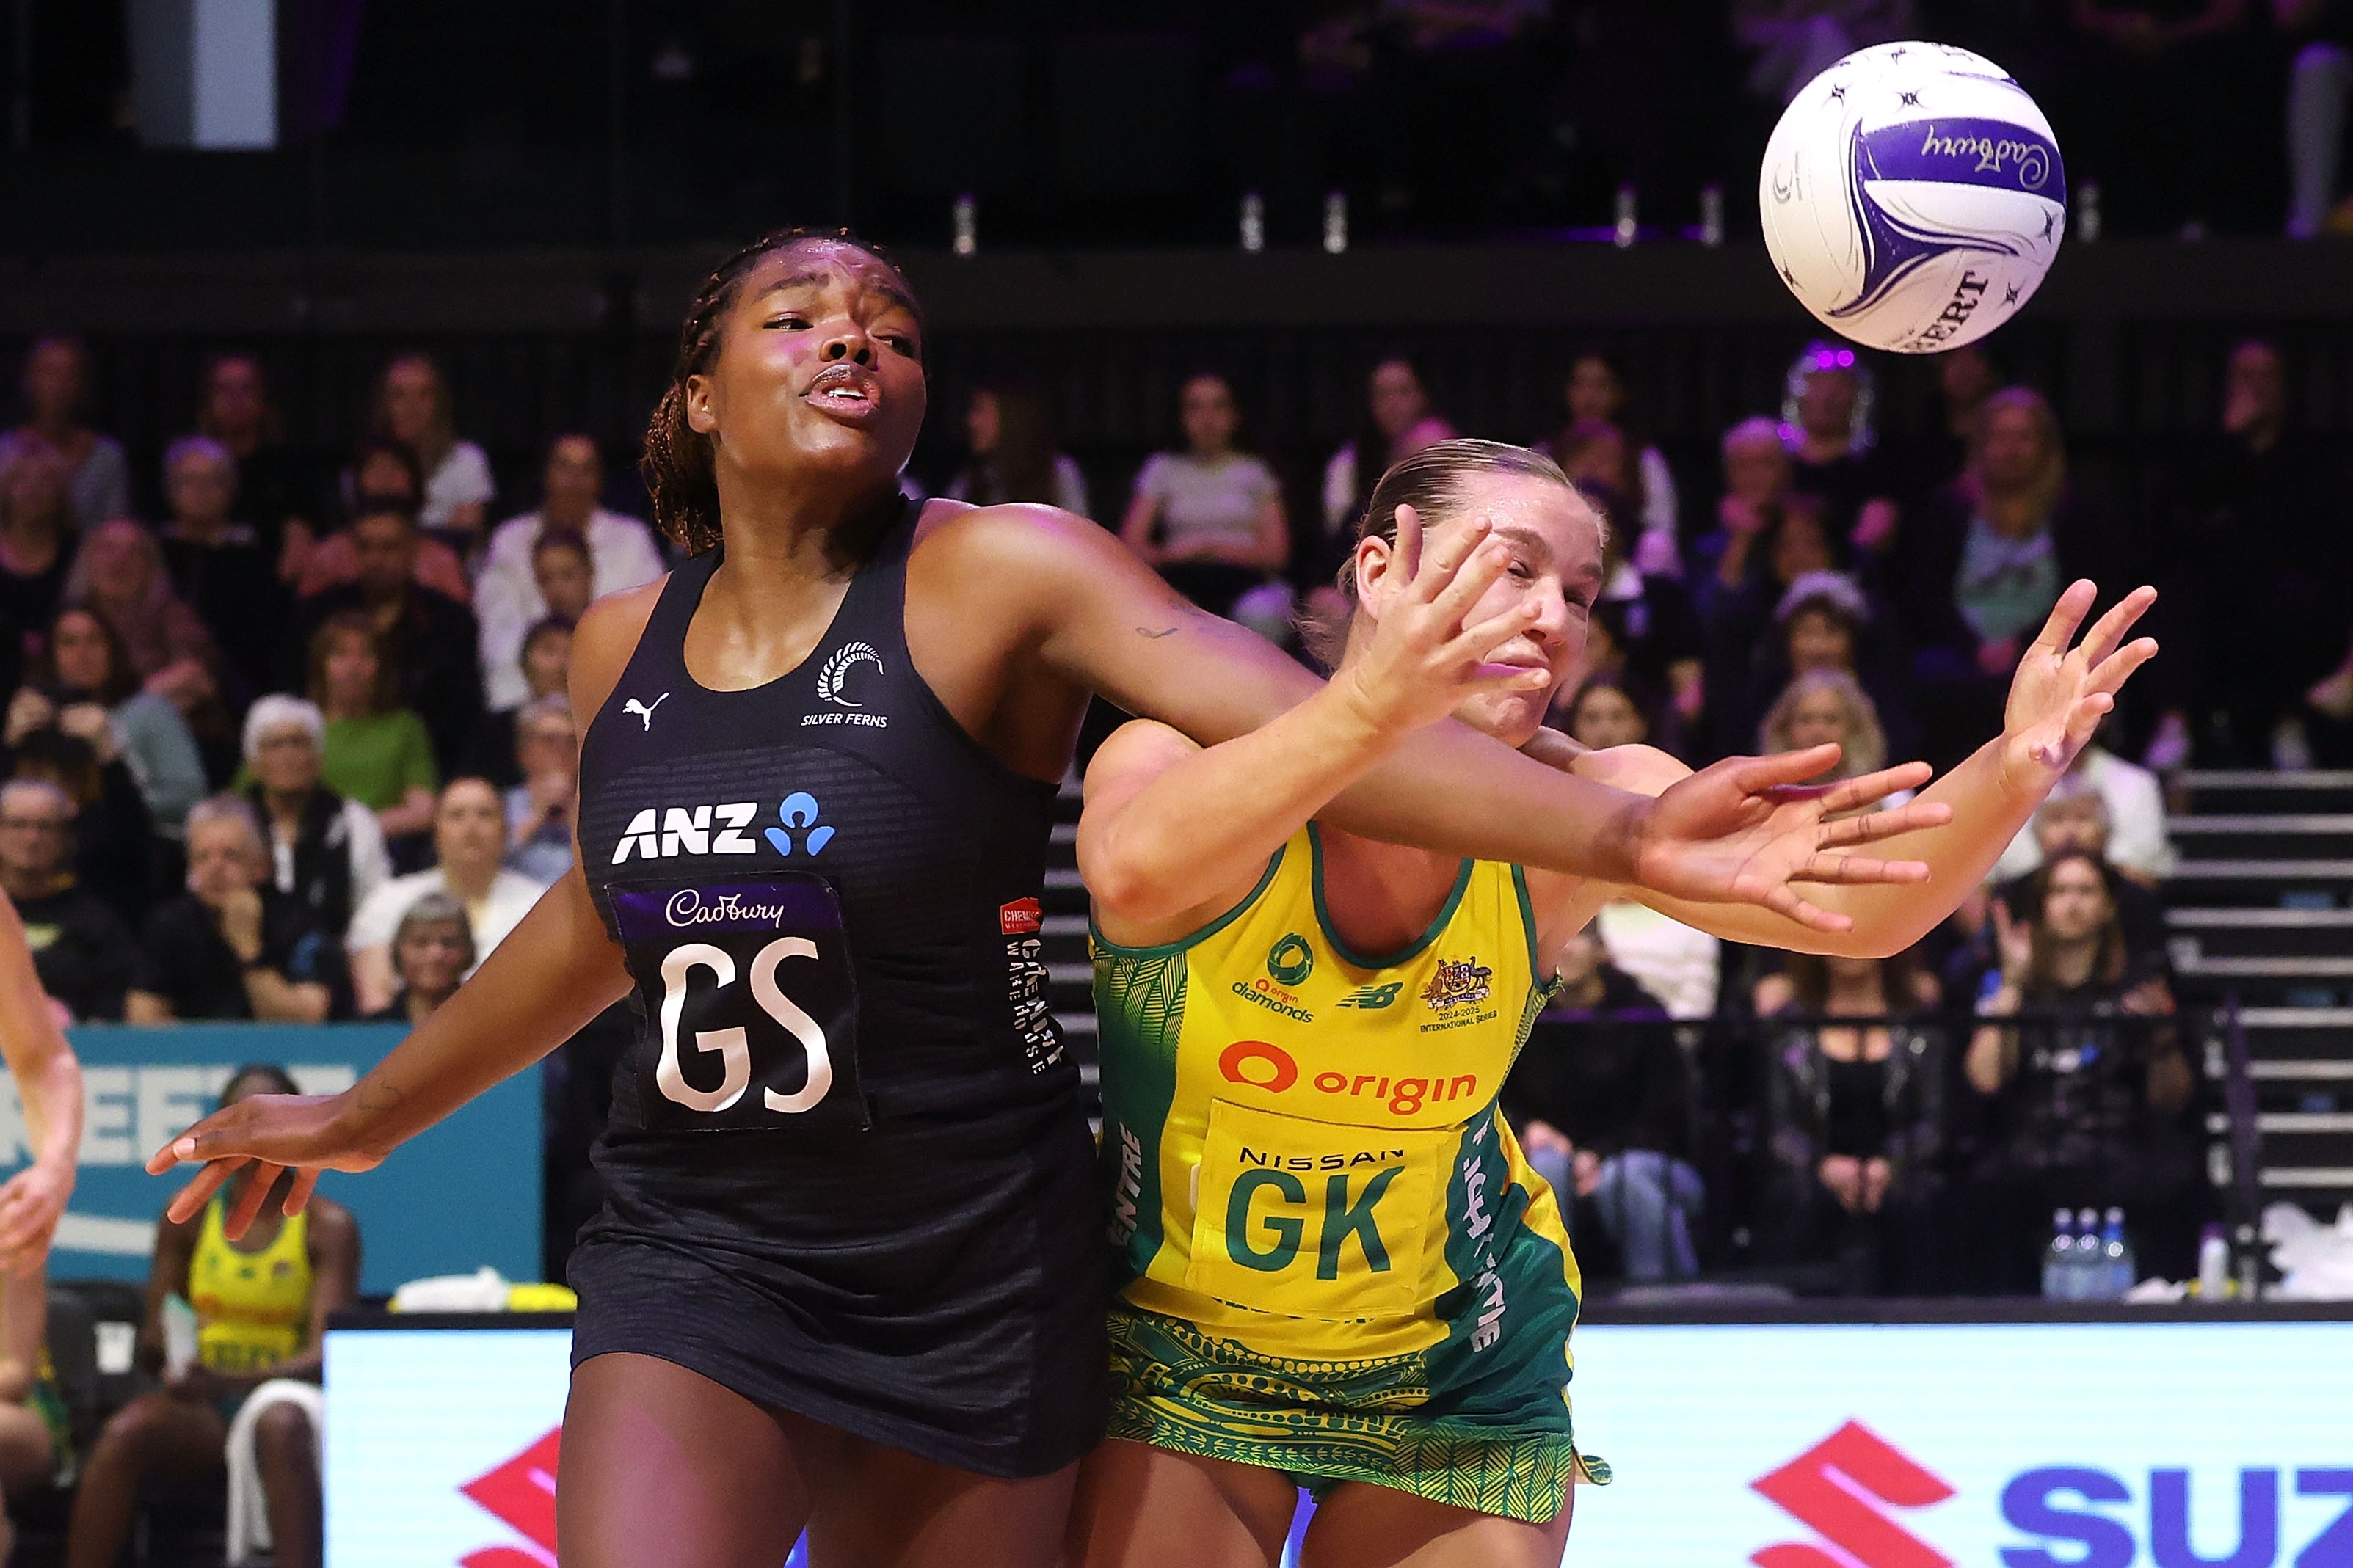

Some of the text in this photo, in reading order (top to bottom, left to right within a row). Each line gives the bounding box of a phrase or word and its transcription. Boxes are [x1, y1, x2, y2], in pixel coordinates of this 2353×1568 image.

[1921, 125, 2050, 190] Cadbury
[1907, 271, 1989, 350] ERT
[801, 713, 888, 728] SILVER FERNS
[612, 802, 757, 865] ANZ
[665, 889, 785, 929] Cadbury
[1006, 941, 1047, 1076] WAREHOUSE
[1232, 982, 1314, 1023] diamonds
[1270, 988, 1298, 1004] origin
[1420, 1010, 1498, 1033] INTERNATIONAL SERIES
[655, 936, 833, 1114] GS
[1314, 1071, 1477, 1116] origin
[1225, 1165, 1405, 1280] GK
